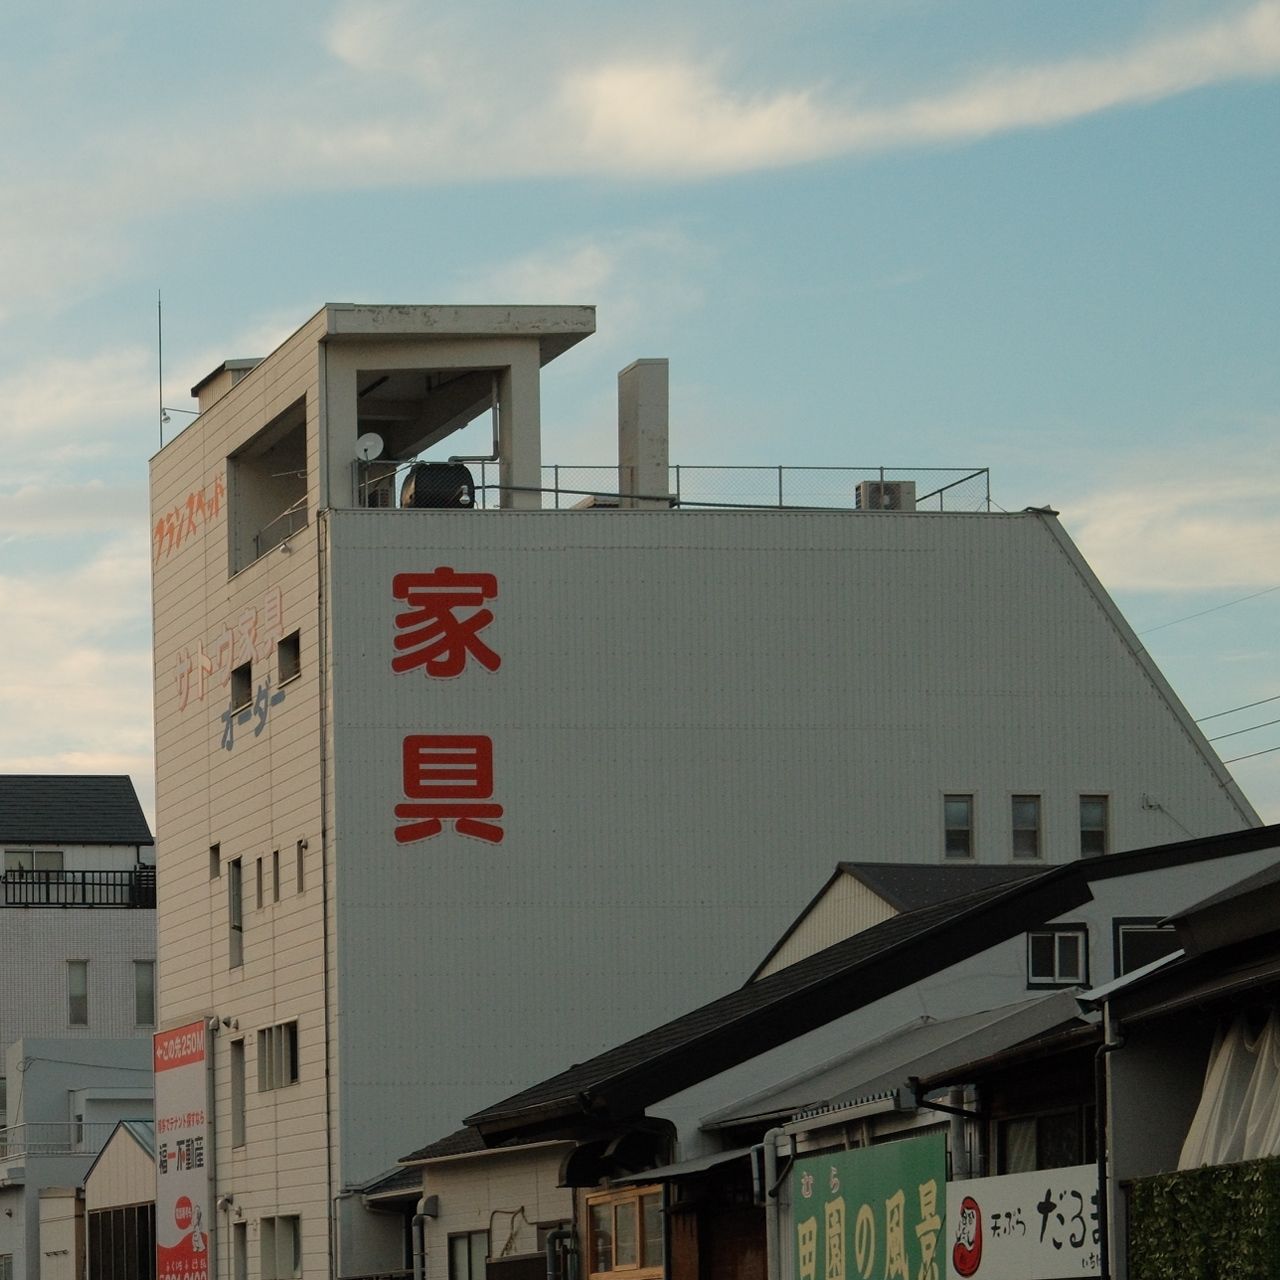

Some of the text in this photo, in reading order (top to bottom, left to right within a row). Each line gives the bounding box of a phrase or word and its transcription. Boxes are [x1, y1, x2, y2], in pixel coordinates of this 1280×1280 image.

[174, 585, 284, 712] サトウ家具
[221, 675, 286, 751] オーダー
[391, 566, 504, 844] 家具
[162, 1030, 204, 1061] この先250M
[159, 1136, 204, 1175] 福一不動産
[990, 1207, 1028, 1238] 天ぷら
